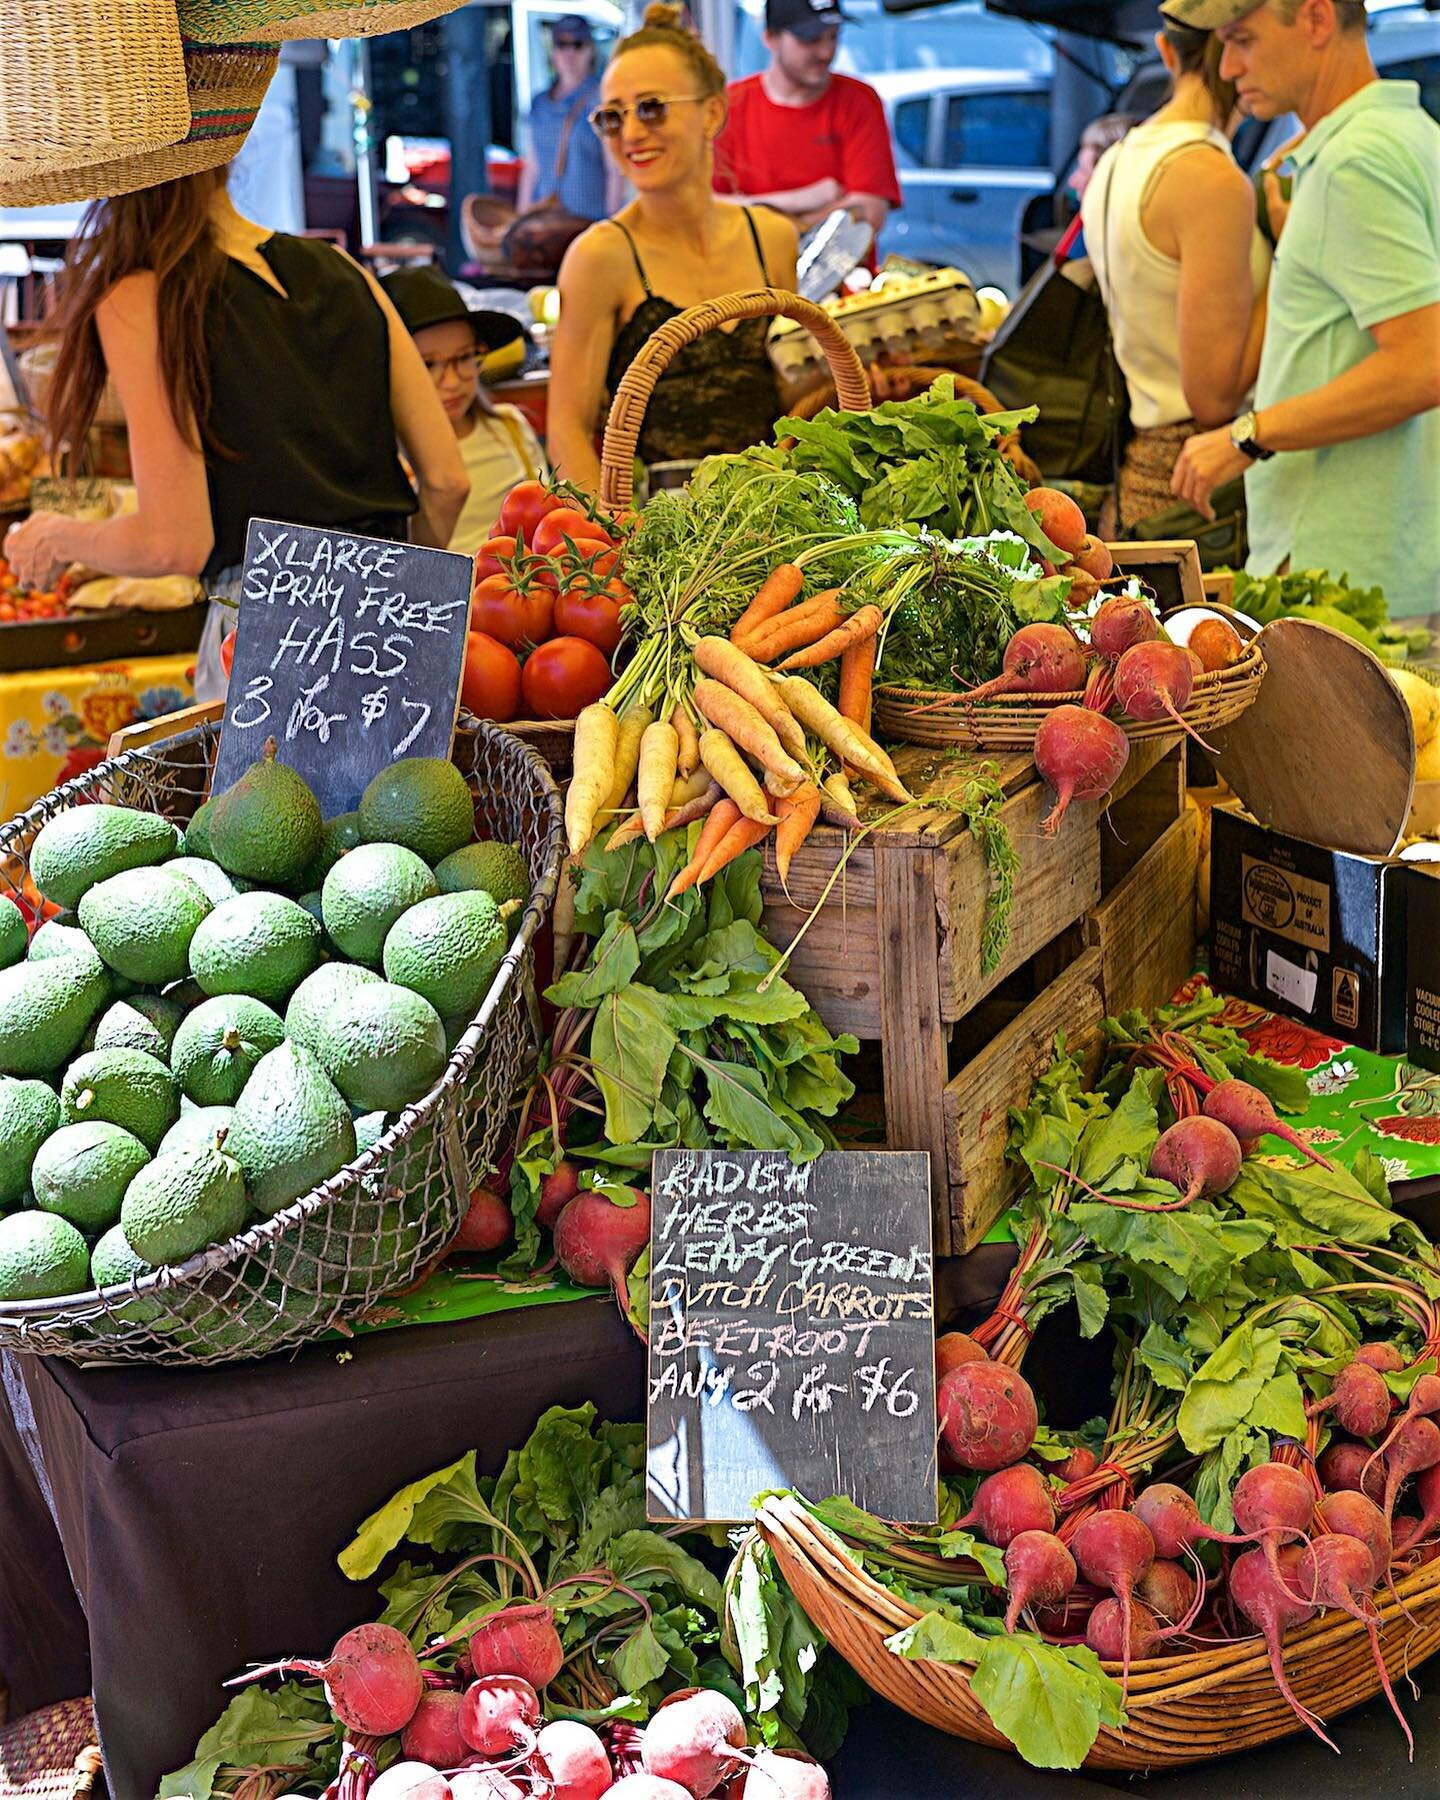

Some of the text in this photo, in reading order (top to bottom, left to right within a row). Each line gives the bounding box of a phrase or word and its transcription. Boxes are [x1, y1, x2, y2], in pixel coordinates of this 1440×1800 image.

[243, 567, 467, 634] SPRAY FREE
[269, 615, 414, 679] HASS
[230, 675, 274, 729] 3
[1413, 1015, 1436, 1035] STORE
[658, 1155, 811, 1197] RADISH
[659, 1199, 817, 1239] HERBS
[653, 1229, 787, 1285] LEAFY
[776, 1280, 933, 1321] CARROTS
[653, 1317, 889, 1358] BEETROOT
[650, 1361, 735, 1407] ANY
[731, 1359, 781, 1415] 2
[853, 1357, 919, 1418] $6
